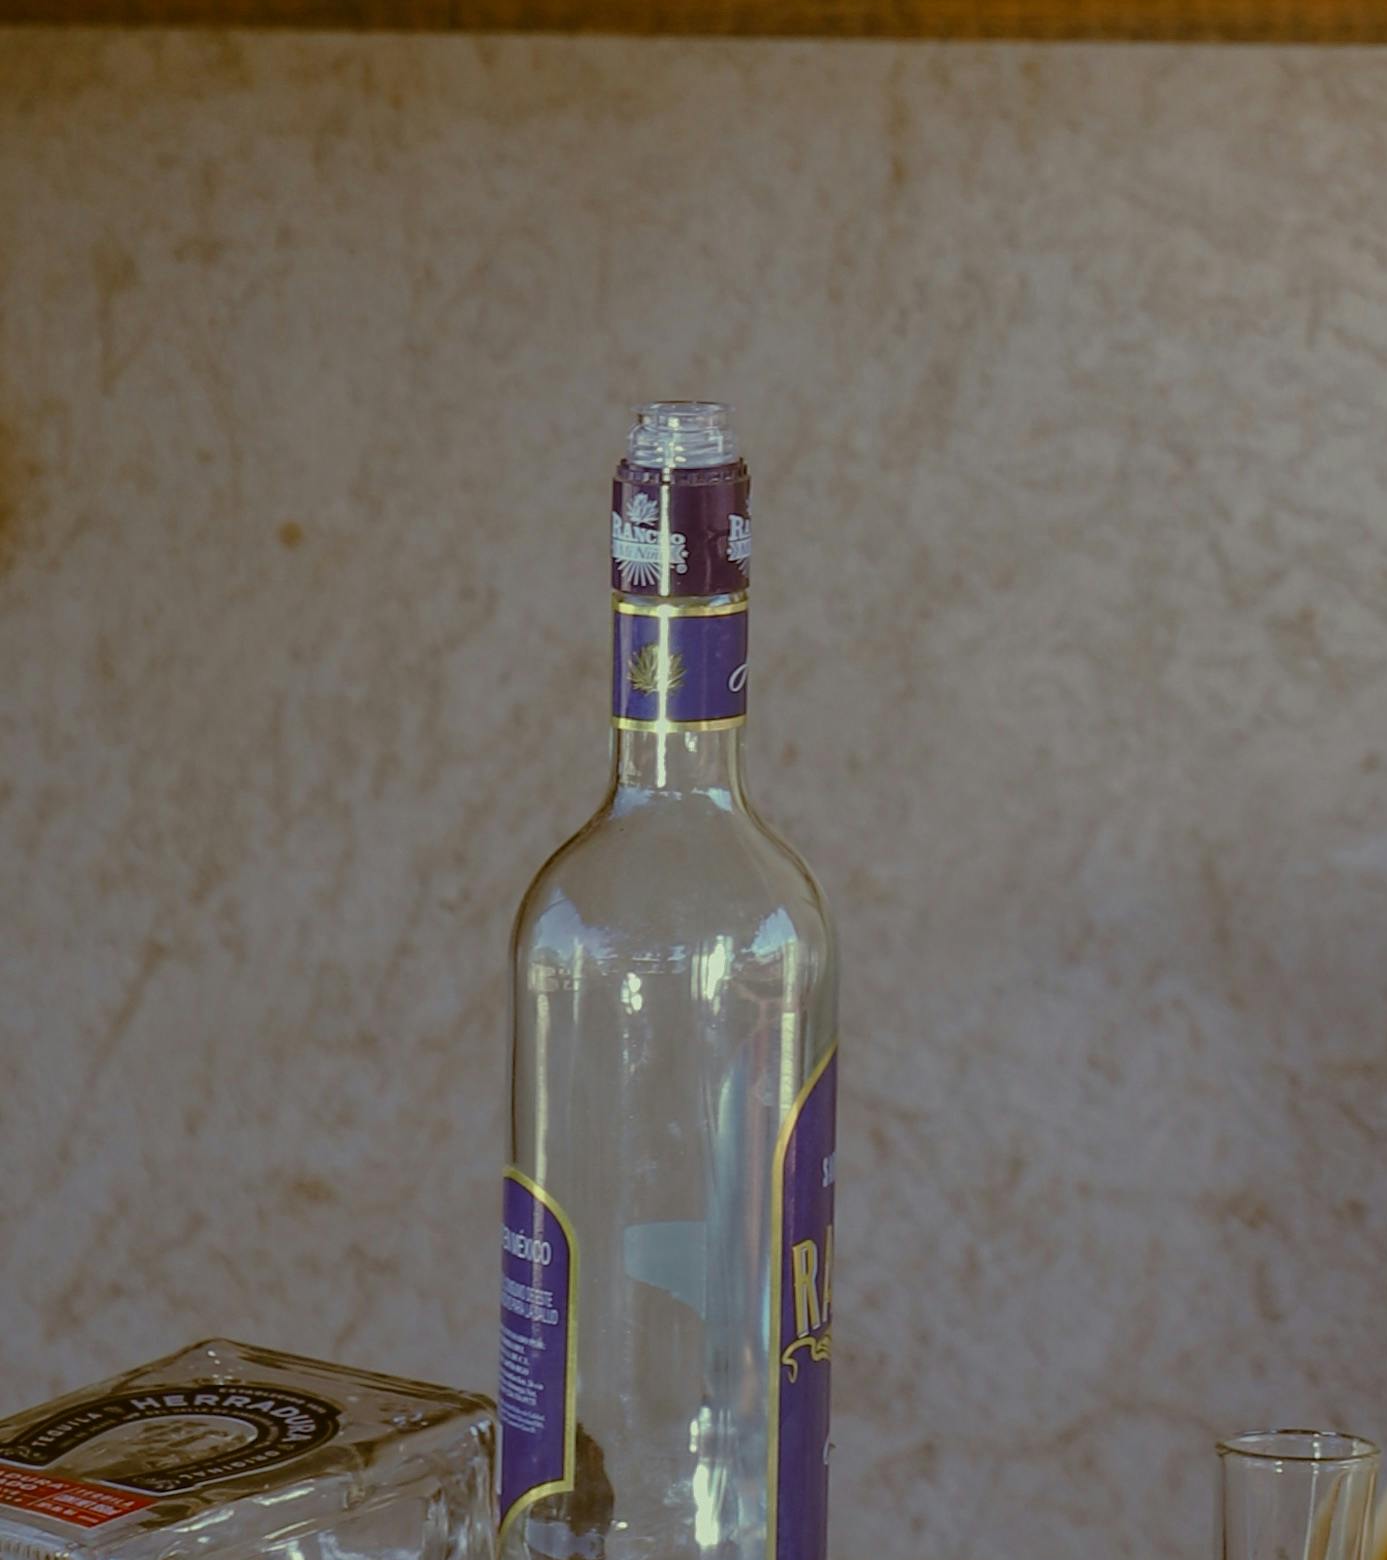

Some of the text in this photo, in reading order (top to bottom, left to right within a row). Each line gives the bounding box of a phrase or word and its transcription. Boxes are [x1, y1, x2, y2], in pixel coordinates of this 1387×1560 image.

[612, 510, 687, 544] RANCO
[31, 1411, 104, 1448] TEQUILA
[130, 1393, 317, 1443] HERRADURA
